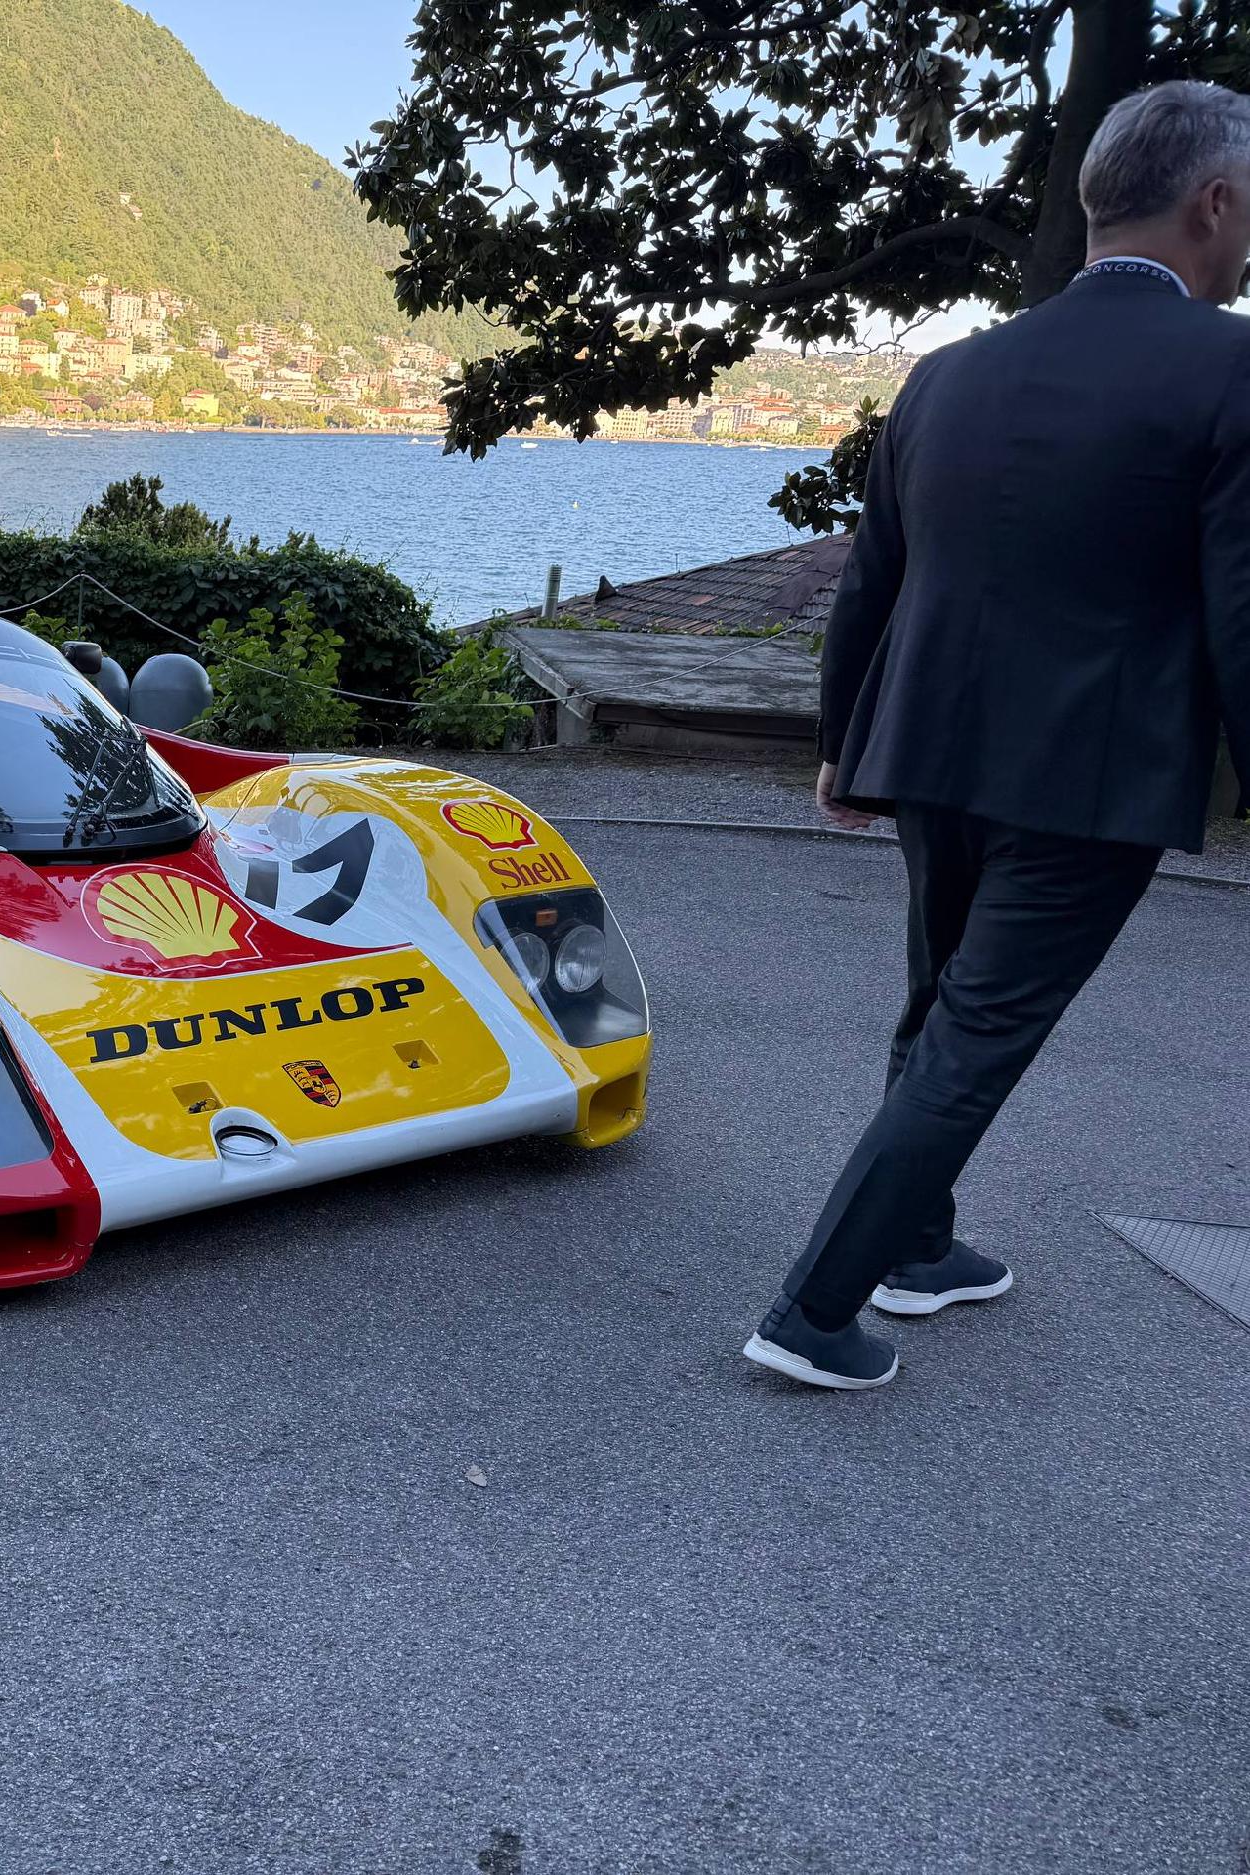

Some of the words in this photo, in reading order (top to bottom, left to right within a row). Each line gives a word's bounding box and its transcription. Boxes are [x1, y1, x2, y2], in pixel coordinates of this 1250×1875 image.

[244, 817, 375, 927] 17
[488, 852, 572, 890] Shell
[86, 977, 426, 1064] DUNLOP
